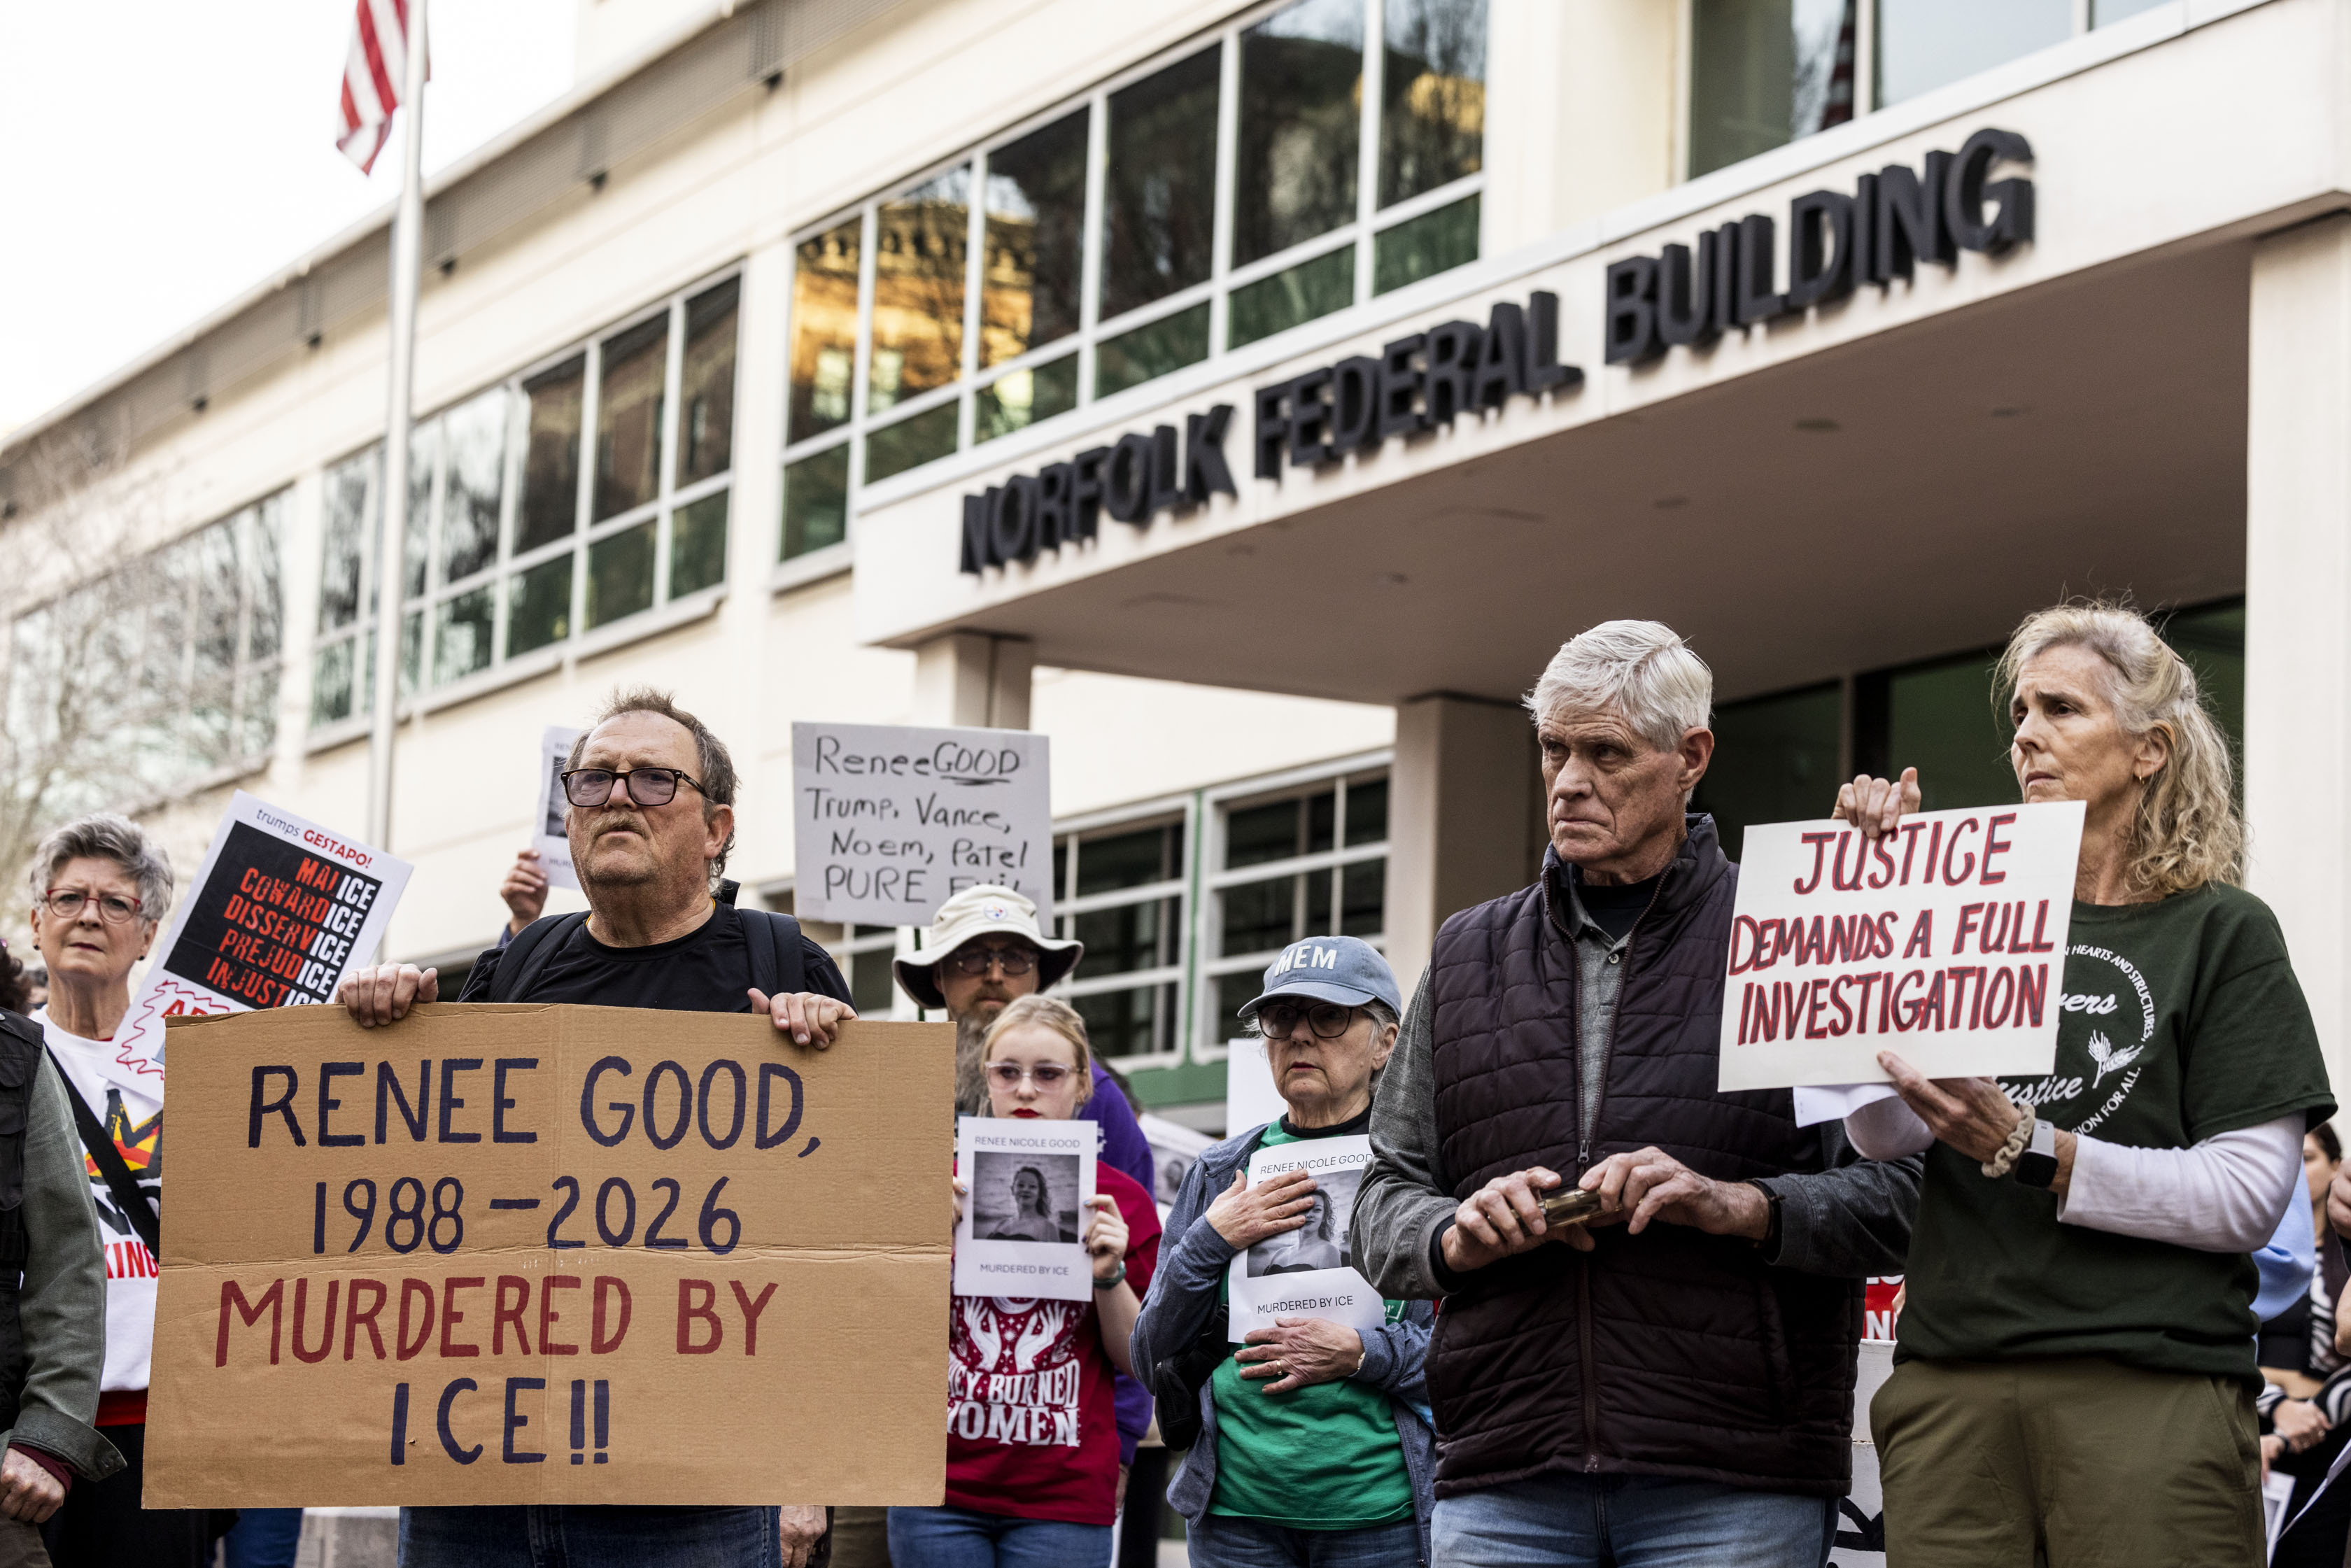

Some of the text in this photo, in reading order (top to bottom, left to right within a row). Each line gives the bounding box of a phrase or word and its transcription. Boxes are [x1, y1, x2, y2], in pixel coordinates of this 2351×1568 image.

[961, 128, 2035, 574] NORFOLK FEDERAL BUILDING
[816, 736, 1020, 776] Renee GOOD
[257, 809, 372, 868] trumps GESTAPO!
[916, 793, 1010, 833] Vance,
[831, 828, 933, 864] Noem,
[1793, 812, 2017, 894] JUSTICE
[240, 868, 363, 938] COWARDICE
[295, 857, 377, 910] MALICE
[825, 864, 927, 903] PURE
[223, 894, 350, 967] DISSERVICE
[1728, 899, 2054, 975] DEMANDS A FULL
[218, 928, 337, 996] PREJUDICE
[1274, 945, 1337, 977] MEM
[1738, 963, 2048, 1045] INVESTIGATION
[2071, 945, 2155, 1042] HEARTS AND STRUCTURES,
[249, 1057, 821, 1158] RENEE GOOD,
[1996, 1075, 2082, 1106] ustice
[2101, 1091, 2126, 1117] FOR
[975, 1136, 1080, 1148] RENEE NICOLE GOOD
[1260, 1154, 1373, 1175] RENEE NICOLE GOOD
[980, 1264, 1069, 1276] MURDERED BY ICE
[217, 1276, 778, 1368] MURDERED BY
[1257, 1295, 1354, 1314] MURDERED BY ICE
[987, 1359, 1080, 1408] BURNED
[391, 1378, 610, 1466] ICE!!
